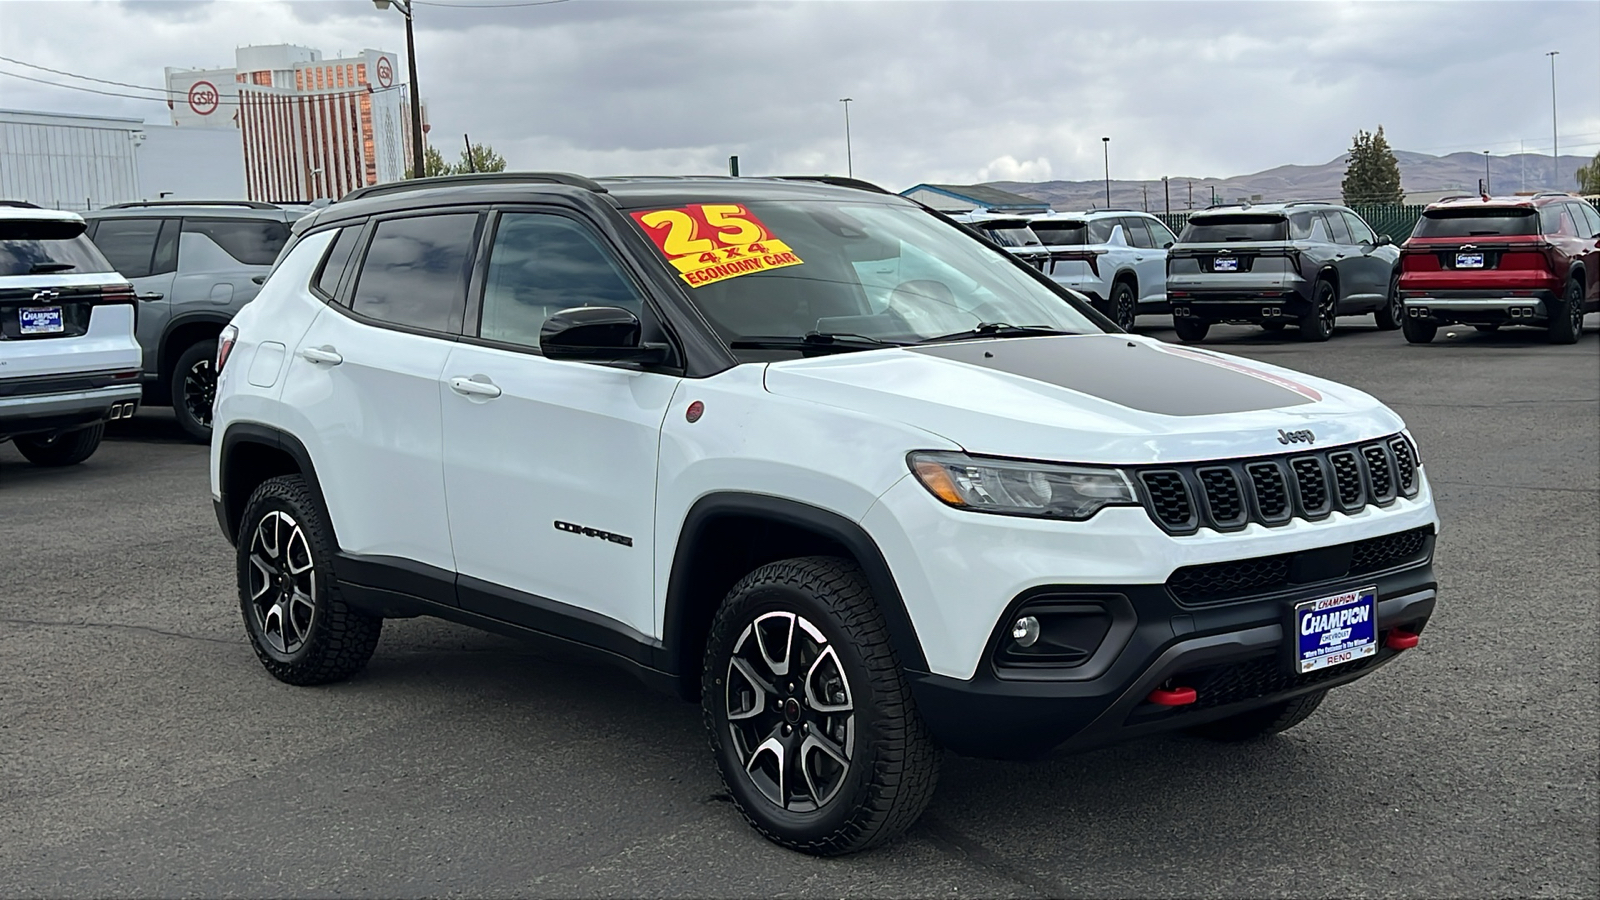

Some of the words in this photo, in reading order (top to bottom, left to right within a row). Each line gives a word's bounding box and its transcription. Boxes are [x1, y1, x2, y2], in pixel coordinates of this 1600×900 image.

[192, 91, 214, 105] GSR
[641, 204, 767, 255] 25
[685, 258, 761, 285] ECONOMY
[764, 252, 796, 266] CAR
[22, 311, 59, 321] CHAMPION
[1277, 429, 1315, 445] Jeep
[554, 520, 633, 548] COMPASS
[1319, 593, 1357, 609] CHAMPION
[1301, 604, 1370, 636] CHAMPION
[1321, 630, 1350, 642] CHEVROLET
[1327, 651, 1352, 665] RENO
